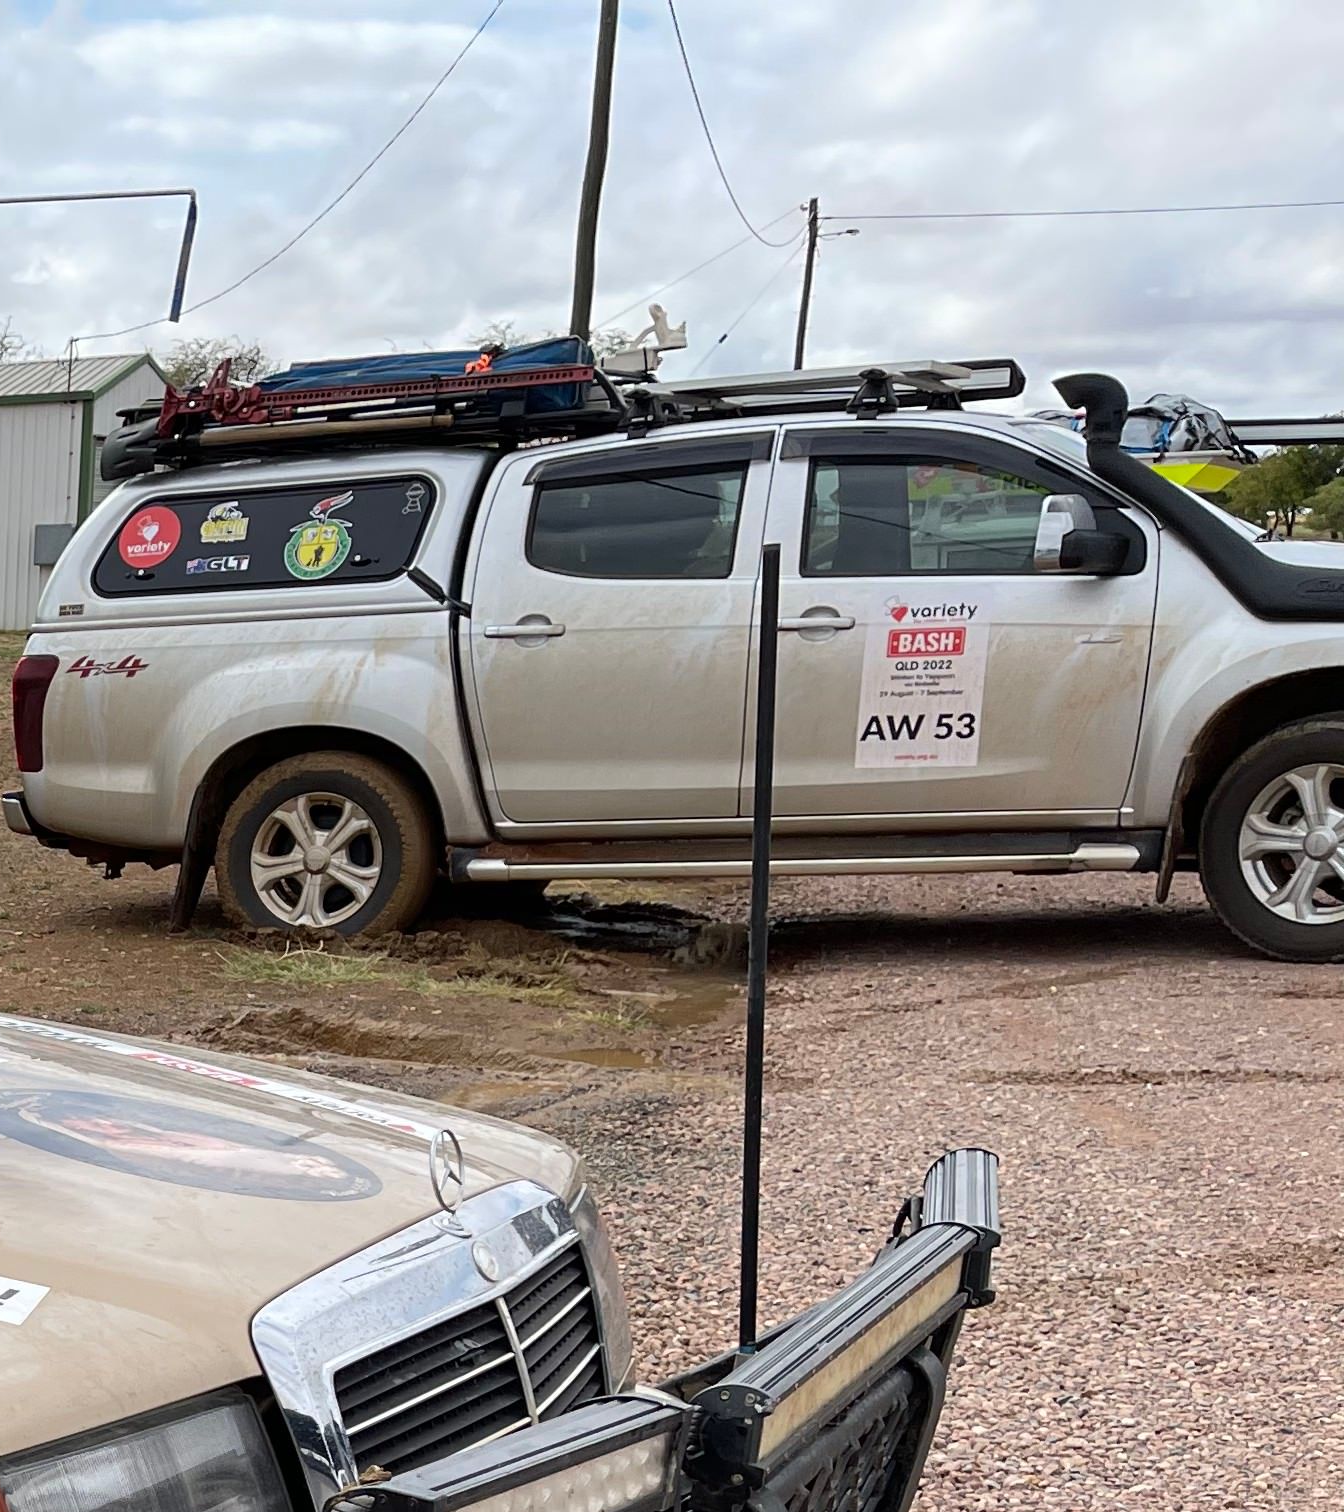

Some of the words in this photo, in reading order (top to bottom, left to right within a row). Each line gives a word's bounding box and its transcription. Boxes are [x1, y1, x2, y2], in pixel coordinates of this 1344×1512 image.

[127, 541, 171, 554] variety
[206, 555, 250, 572] GLT
[910, 602, 978, 619] variety
[898, 632, 955, 653] BASH
[895, 661, 919, 671] QLD
[923, 660, 953, 670] 2022
[860, 714, 925, 742] AW
[934, 713, 976, 740] 53
